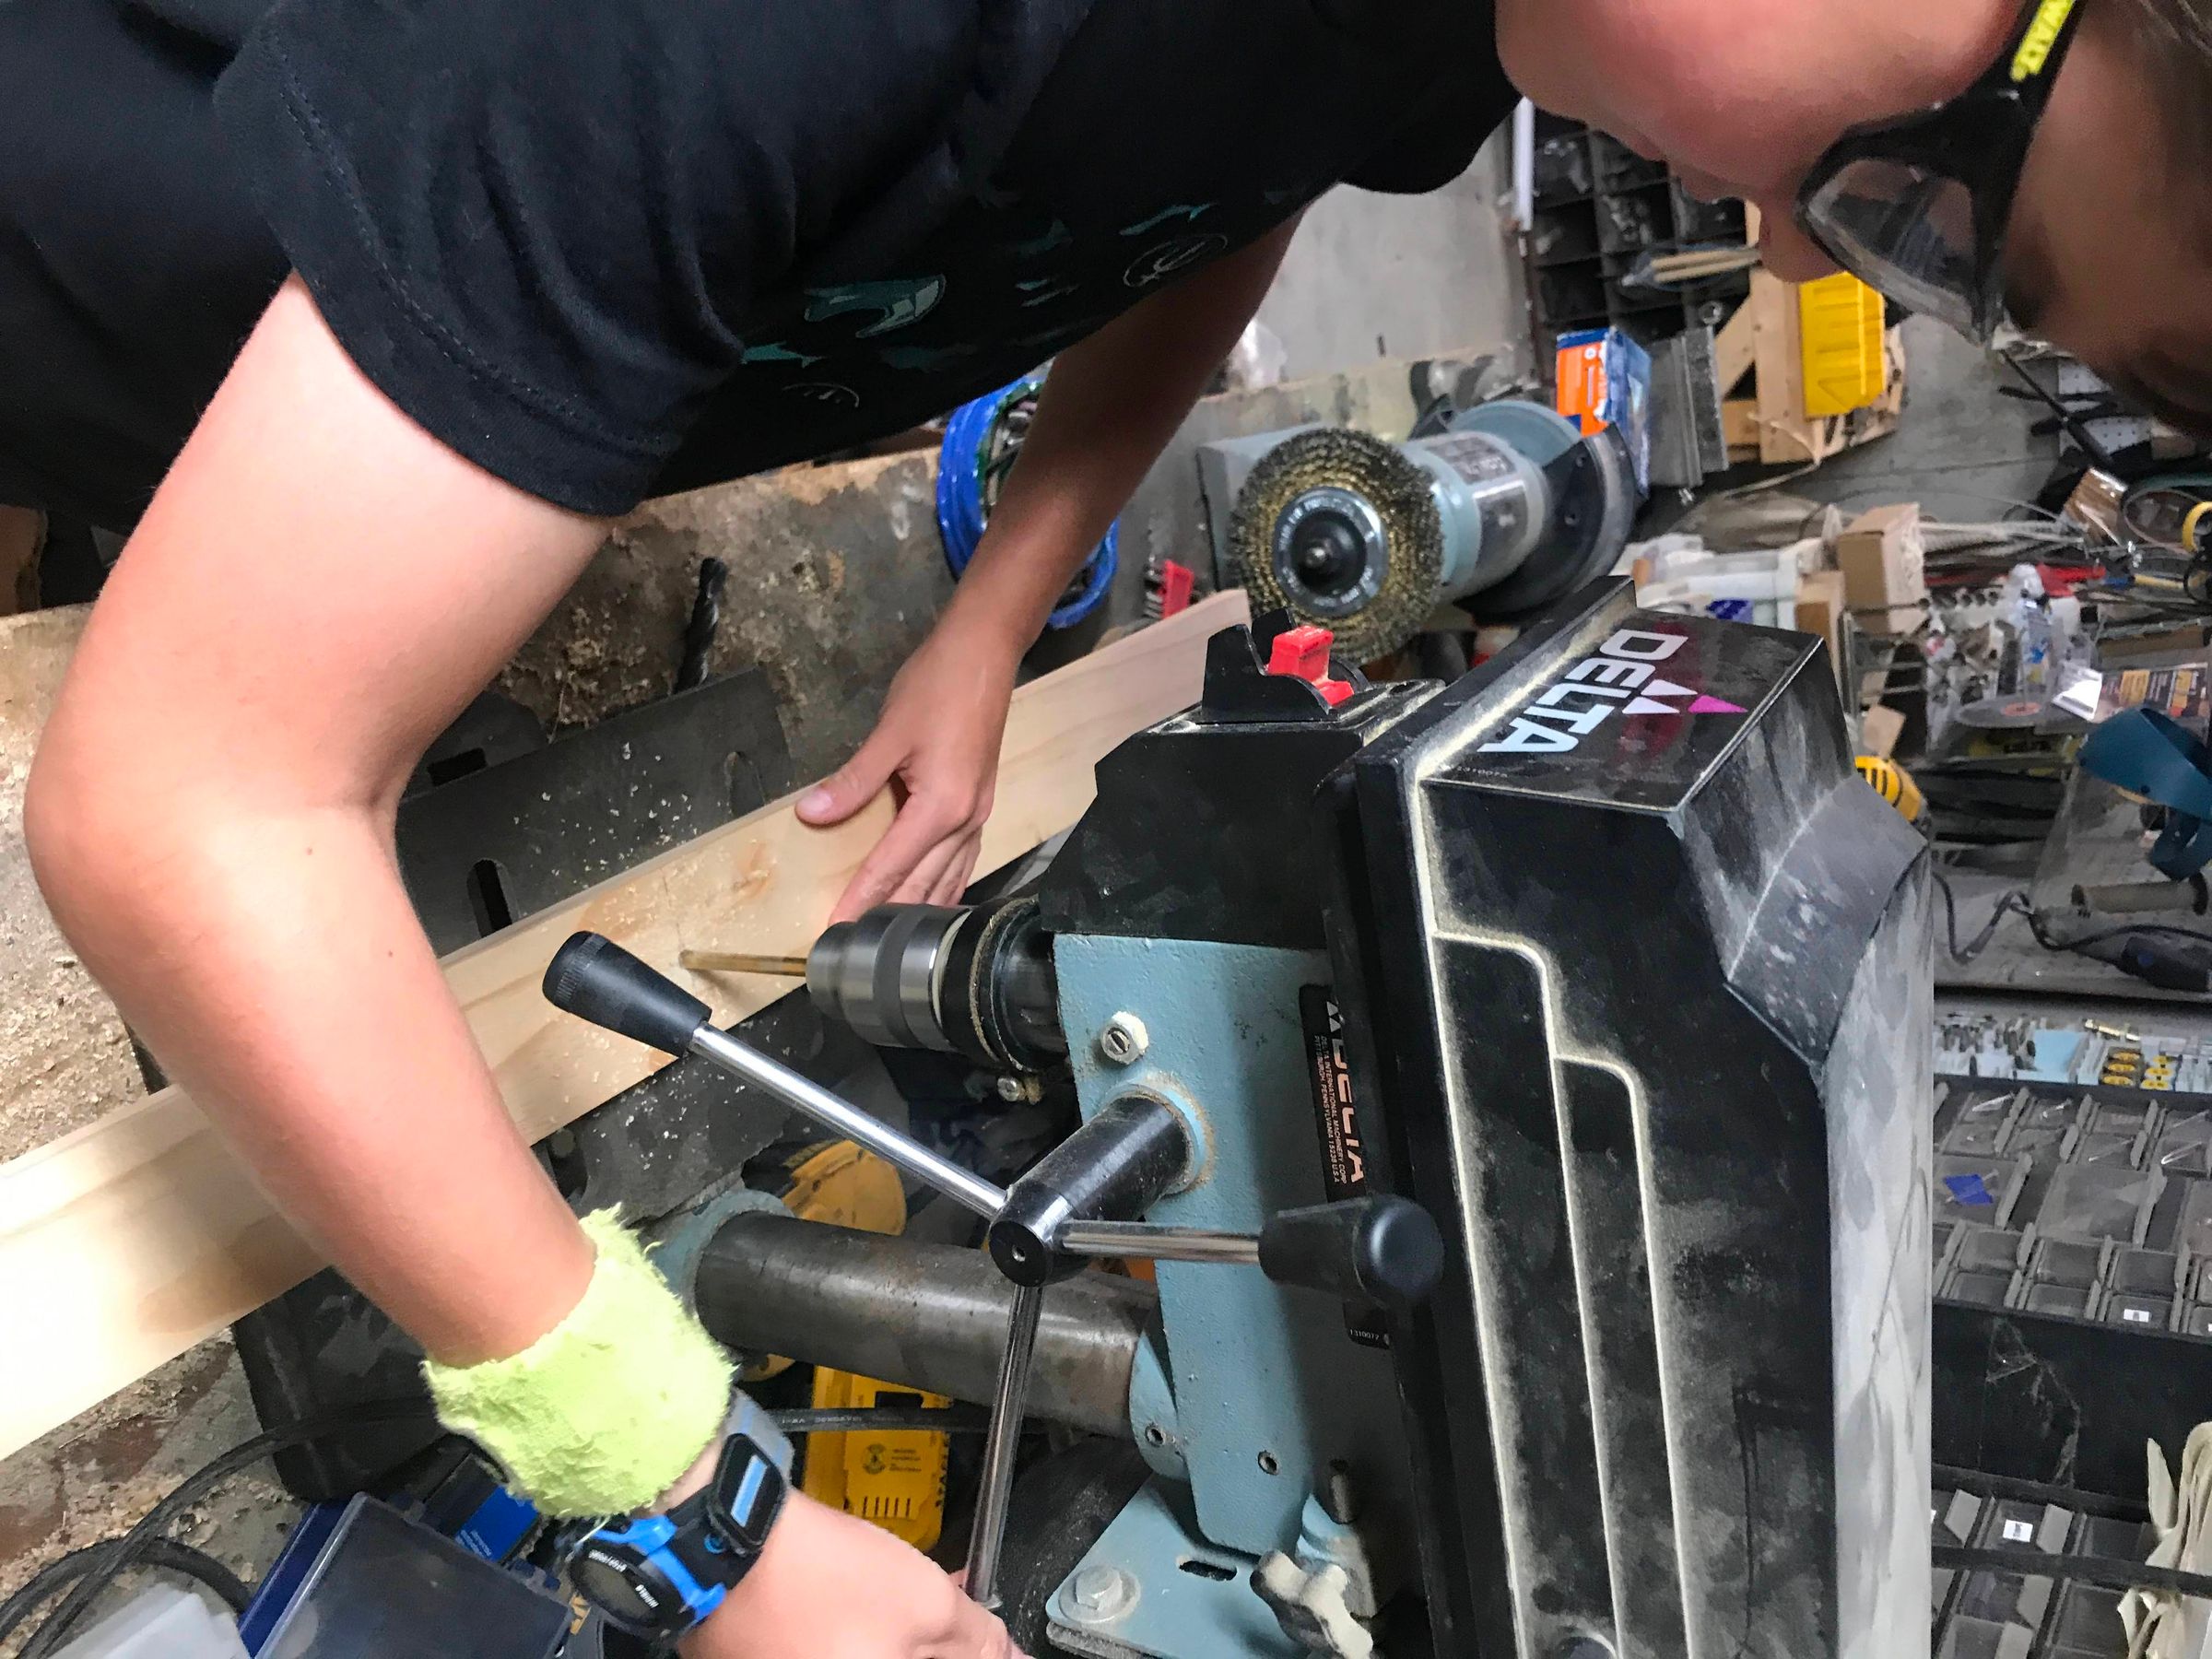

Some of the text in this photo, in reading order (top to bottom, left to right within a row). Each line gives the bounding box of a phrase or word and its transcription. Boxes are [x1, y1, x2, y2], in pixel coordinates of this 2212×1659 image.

[1477, 629, 1688, 752] DELTA
[1321, 1035, 1331, 1059] DELTA
[1321, 1084, 1334, 1138] PENNSYLVANIA
[1324, 1061, 1337, 1118] INTERNATIONAL
[1333, 1119, 1344, 1162] MACHINERY
